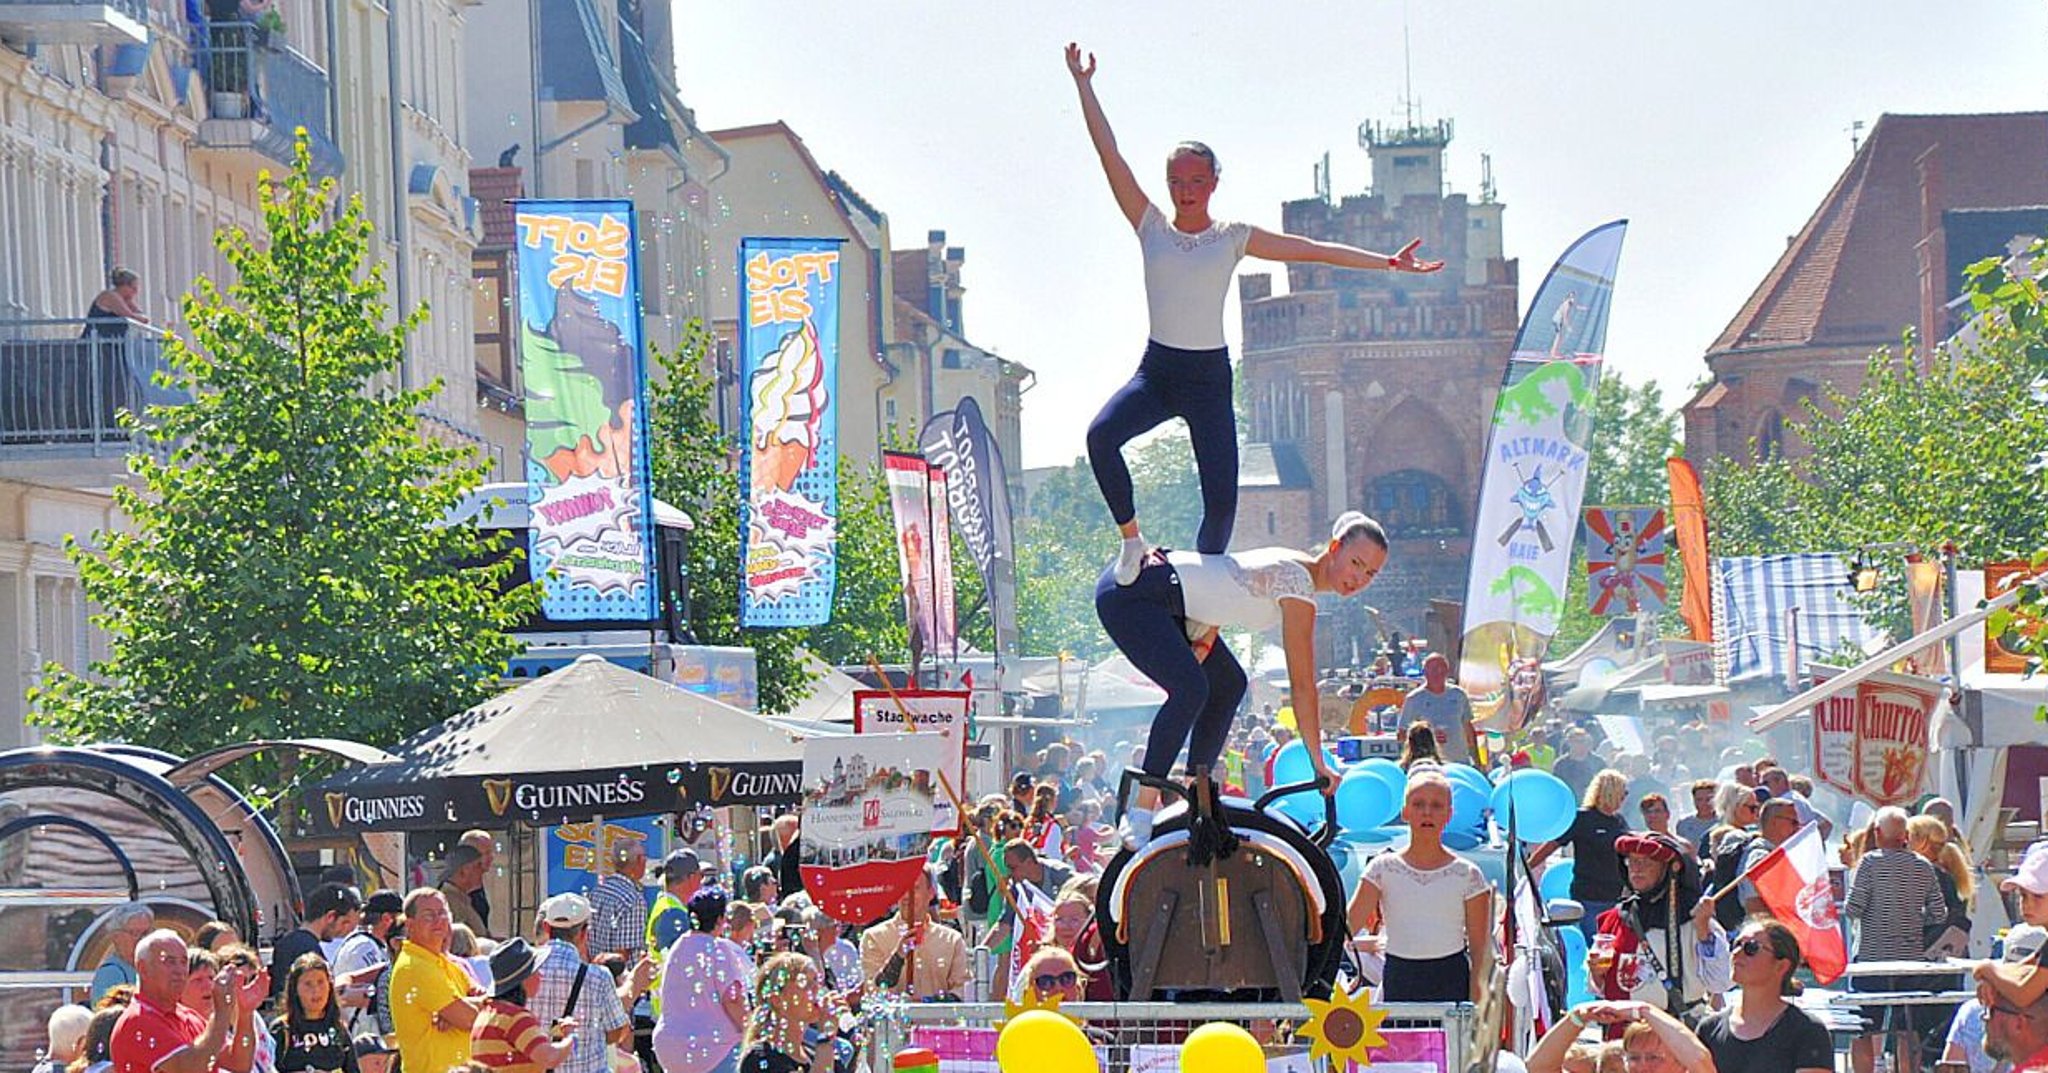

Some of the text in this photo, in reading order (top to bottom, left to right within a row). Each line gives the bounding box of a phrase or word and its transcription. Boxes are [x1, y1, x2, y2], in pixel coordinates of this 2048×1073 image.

[746, 251, 839, 292] SOFT
[749, 288, 814, 328] EIS
[1500, 437, 1586, 471] ALTMARK
[1508, 541, 1540, 560] HAIE
[515, 780, 646, 810] GUINNESS
[731, 771, 805, 797] GUINN
[345, 795, 426, 823] GUINNESS
